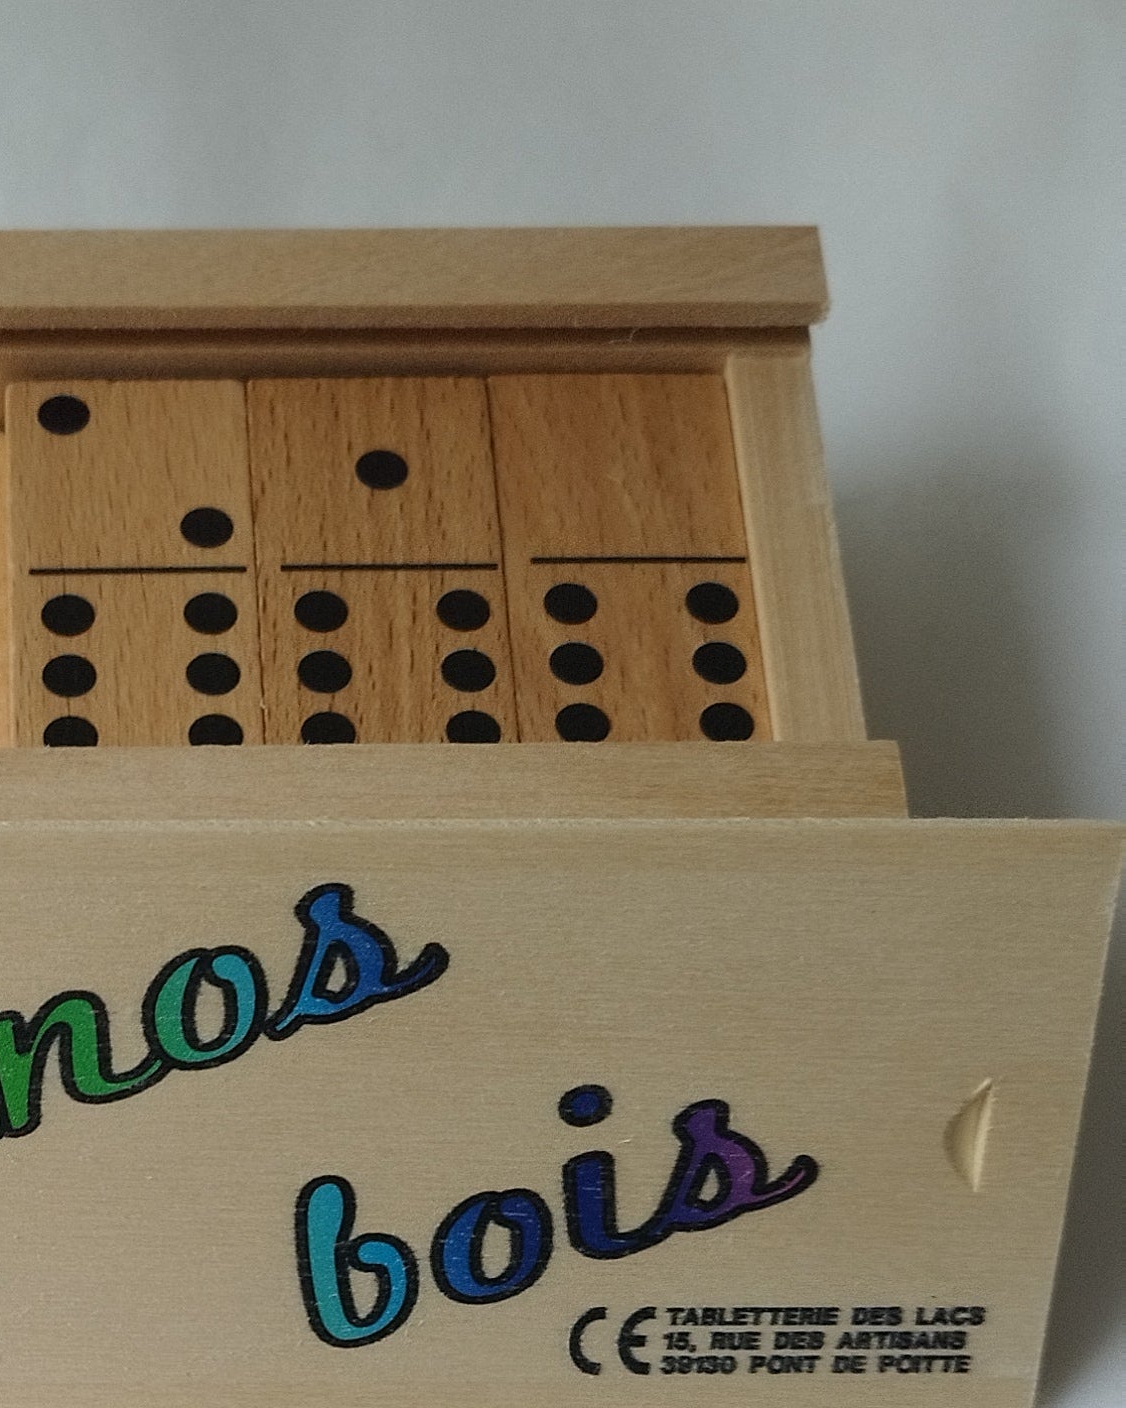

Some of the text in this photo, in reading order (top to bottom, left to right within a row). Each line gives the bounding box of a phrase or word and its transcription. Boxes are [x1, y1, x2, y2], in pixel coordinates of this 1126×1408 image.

[296, 1084, 818, 1347] bois
[666, 1306, 987, 1325] TABLETTERIE DES LACS
[662, 1331, 967, 1352] 15, RUE DES ARTISANS
[659, 1355, 971, 1374] 39130 PONT DE POITTE
